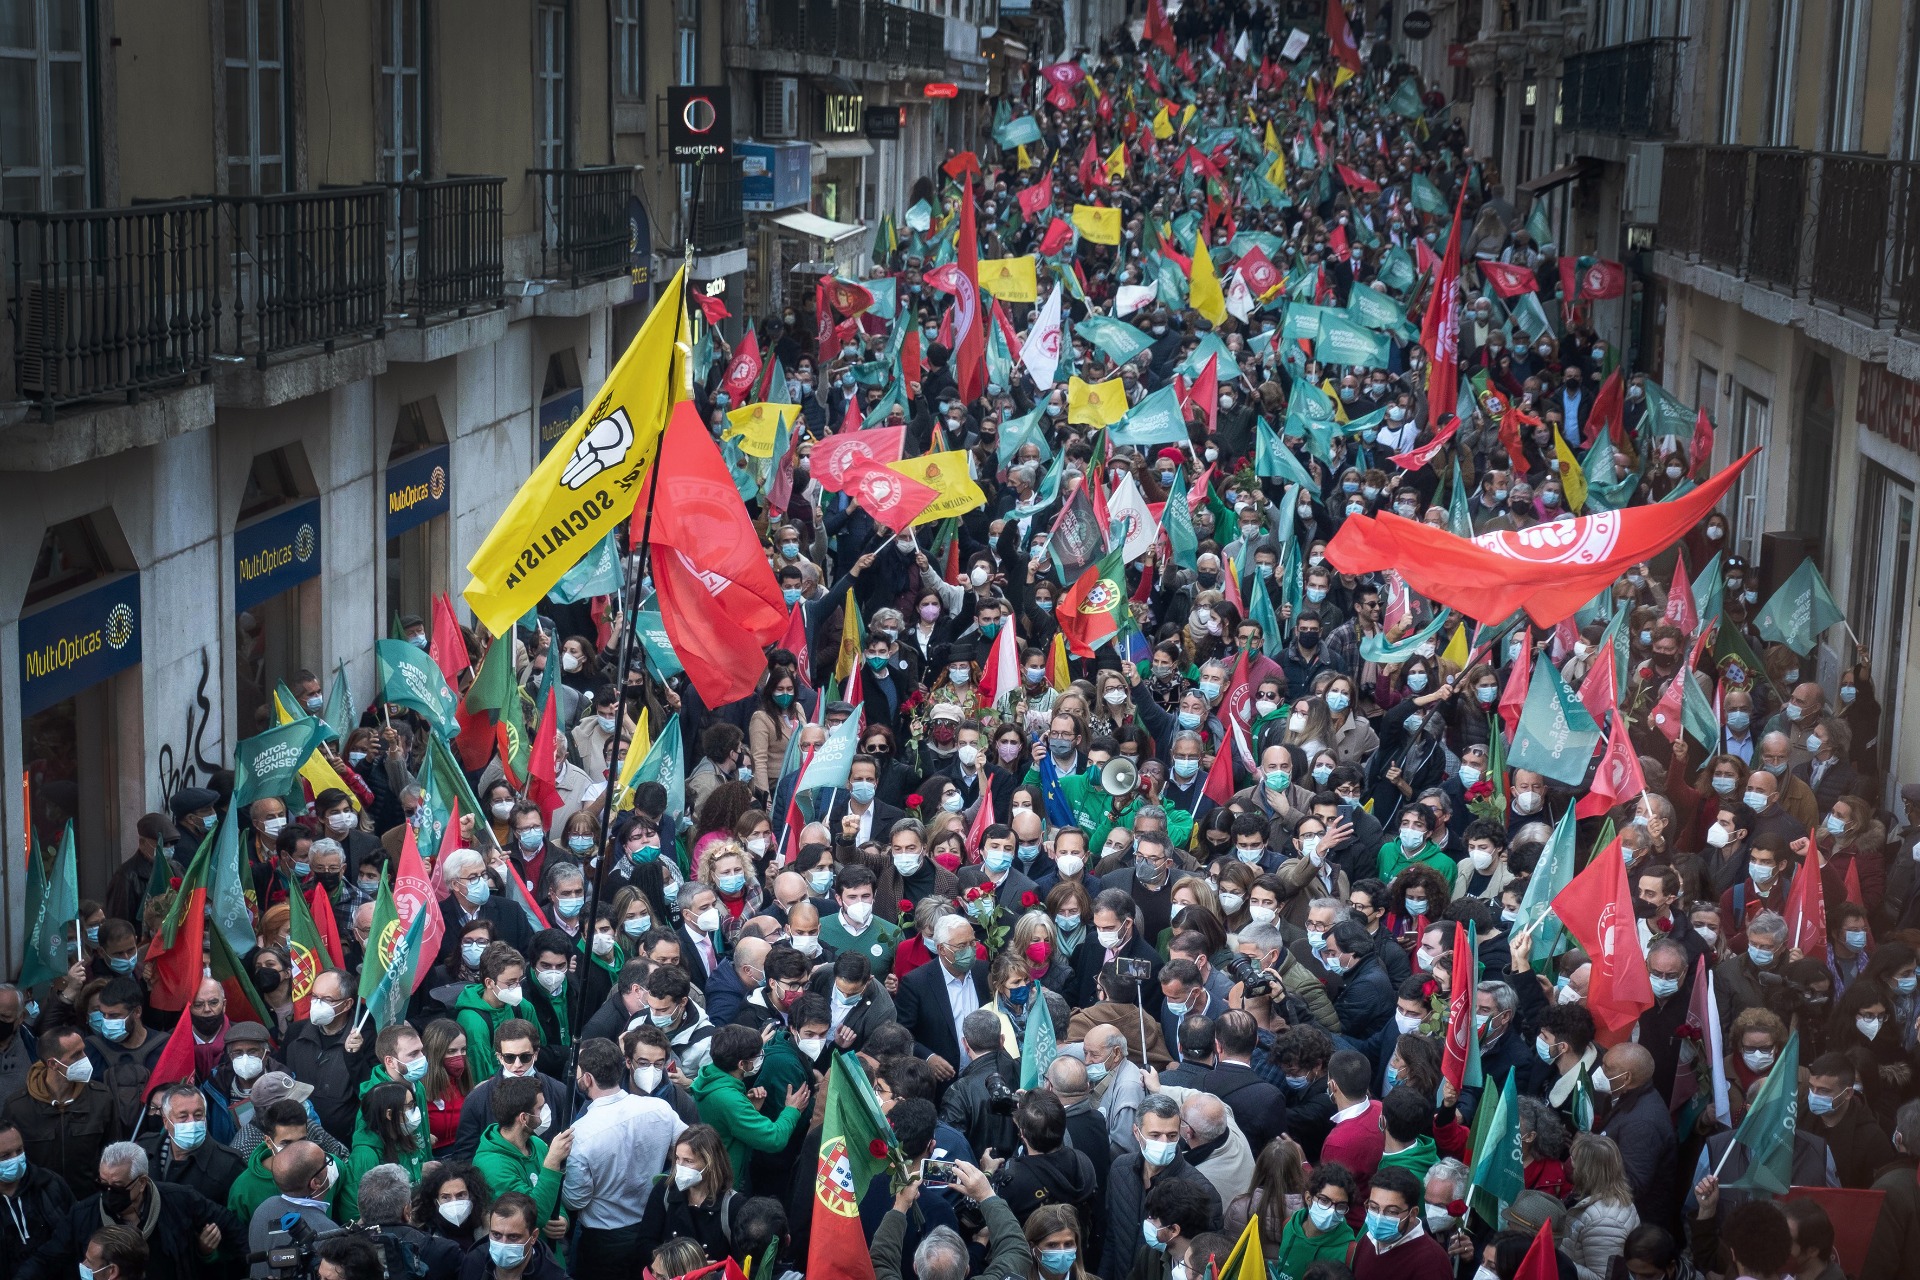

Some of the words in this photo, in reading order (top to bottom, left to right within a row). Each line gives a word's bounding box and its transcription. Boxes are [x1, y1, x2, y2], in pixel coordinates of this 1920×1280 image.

[825, 94, 863, 133] INGLOT
[674, 144, 718, 155] swatch
[389, 481, 429, 515] MultiOpticas
[239, 543, 293, 584] MultiOpticas
[26, 629, 102, 682] MultiOpticas
[397, 661, 428, 684] JUNTOS
[252, 741, 288, 767] JUNTOS
